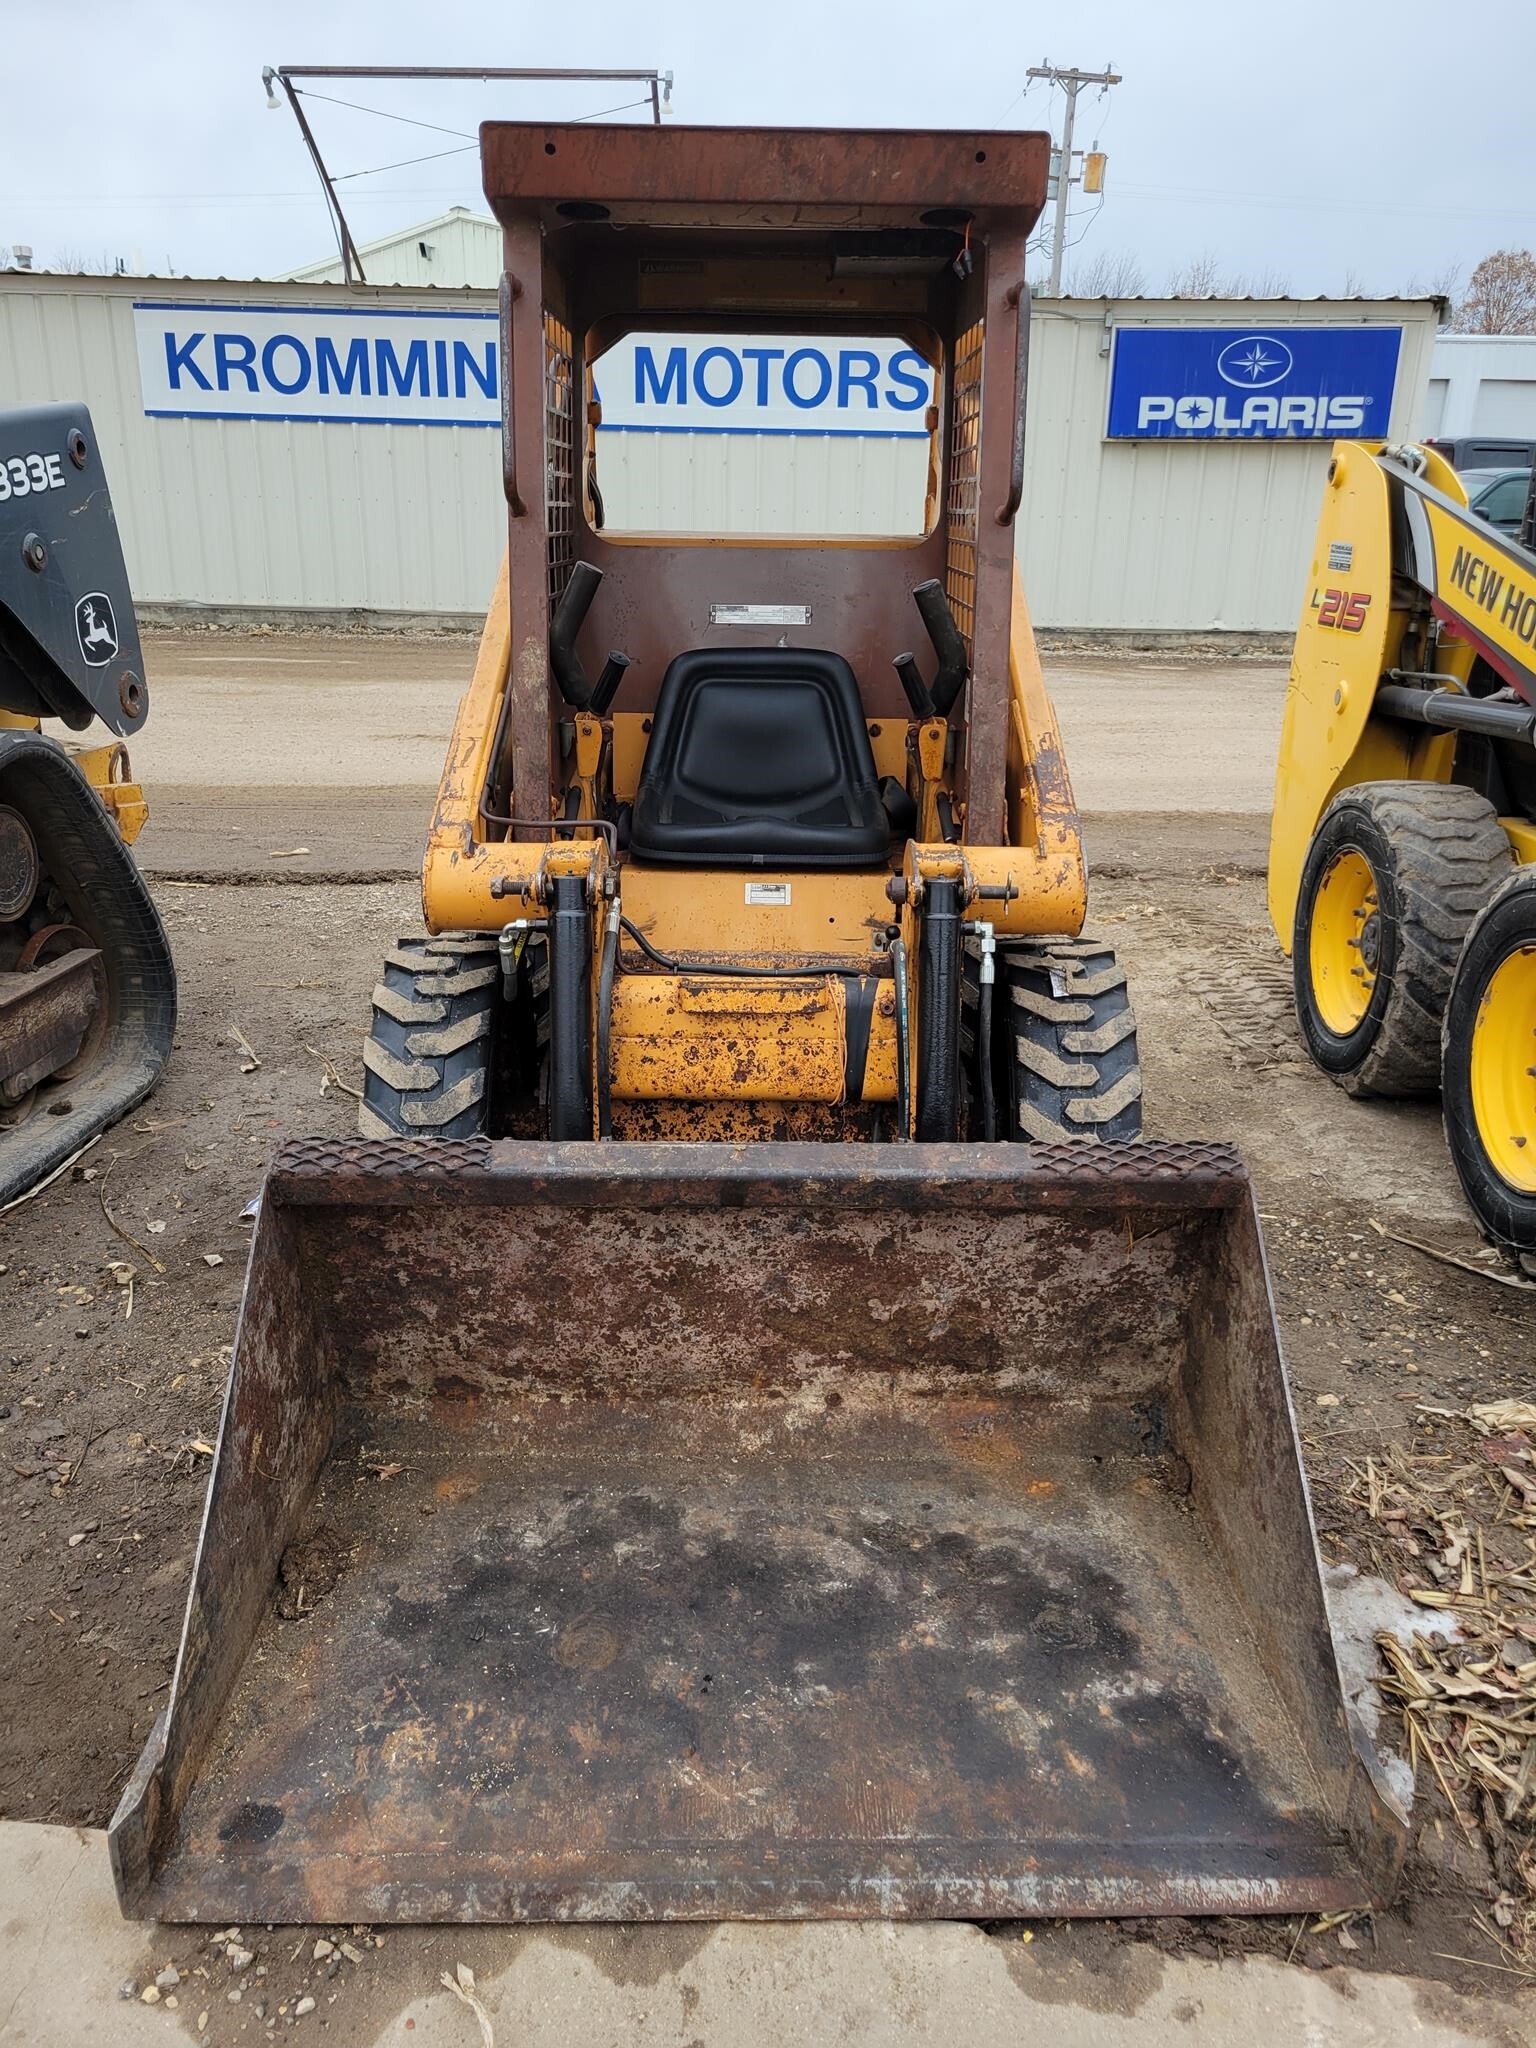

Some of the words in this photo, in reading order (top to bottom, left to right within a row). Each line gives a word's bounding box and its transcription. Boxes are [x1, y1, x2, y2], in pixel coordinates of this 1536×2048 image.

[164, 332, 601, 401] KROMMIN
[634, 345, 930, 412] MOTORS
[1137, 396, 1365, 430] POLARIS
[1310, 588, 1372, 633] L215
[1449, 545, 1505, 613] NEW
[1500, 583, 1536, 651] HO
